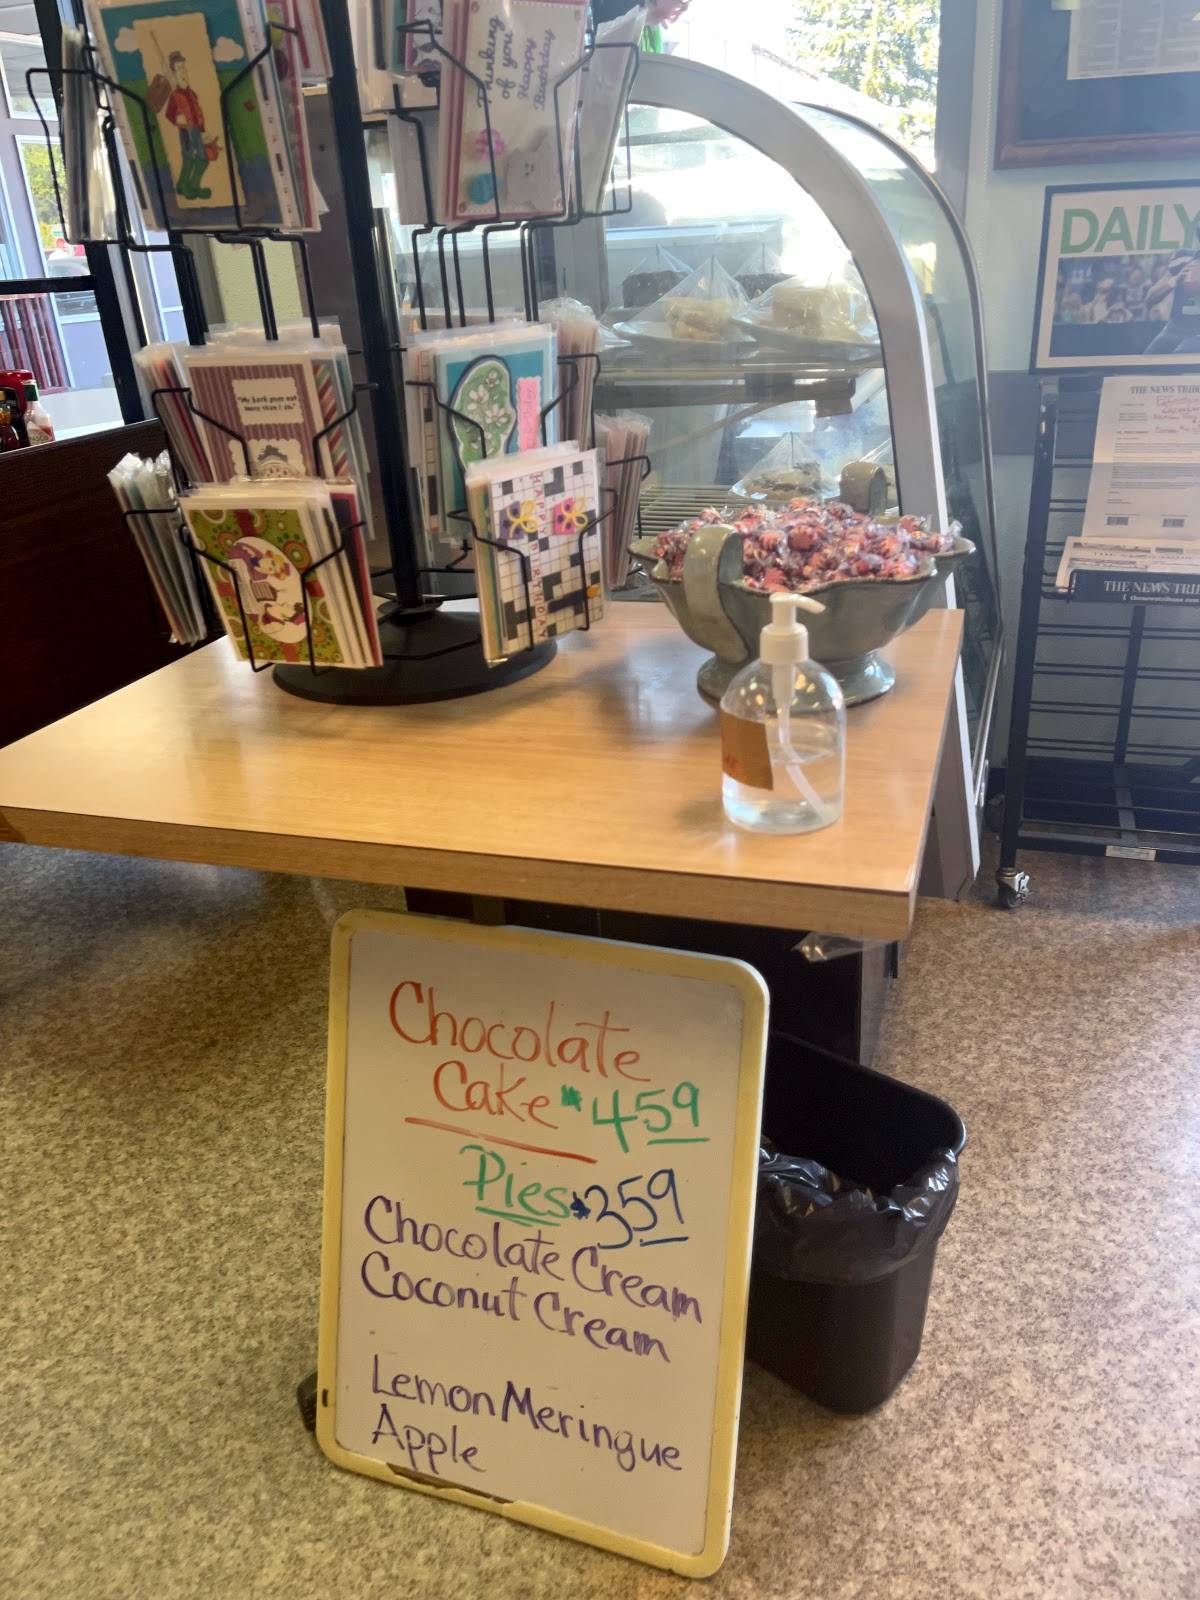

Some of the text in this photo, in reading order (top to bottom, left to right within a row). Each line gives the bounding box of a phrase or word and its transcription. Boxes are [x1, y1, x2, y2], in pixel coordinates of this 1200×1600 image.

[496, 30, 518, 100] of you
[517, 37, 538, 99] Happy
[1060, 203, 1200, 254] DAILY
[1104, 580, 1130, 592] THE
[1133, 582, 1169, 593] NEWS
[390, 980, 651, 1082] Chocolate
[433, 1059, 559, 1129] Cake
[460, 1145, 570, 1218] Pies
[364, 1194, 703, 1324] Chocolate Cream
[361, 1250, 671, 1364] Coconut Cream
[372, 1354, 682, 1473] Lemon Meringue
[372, 1403, 487, 1474] Apple
